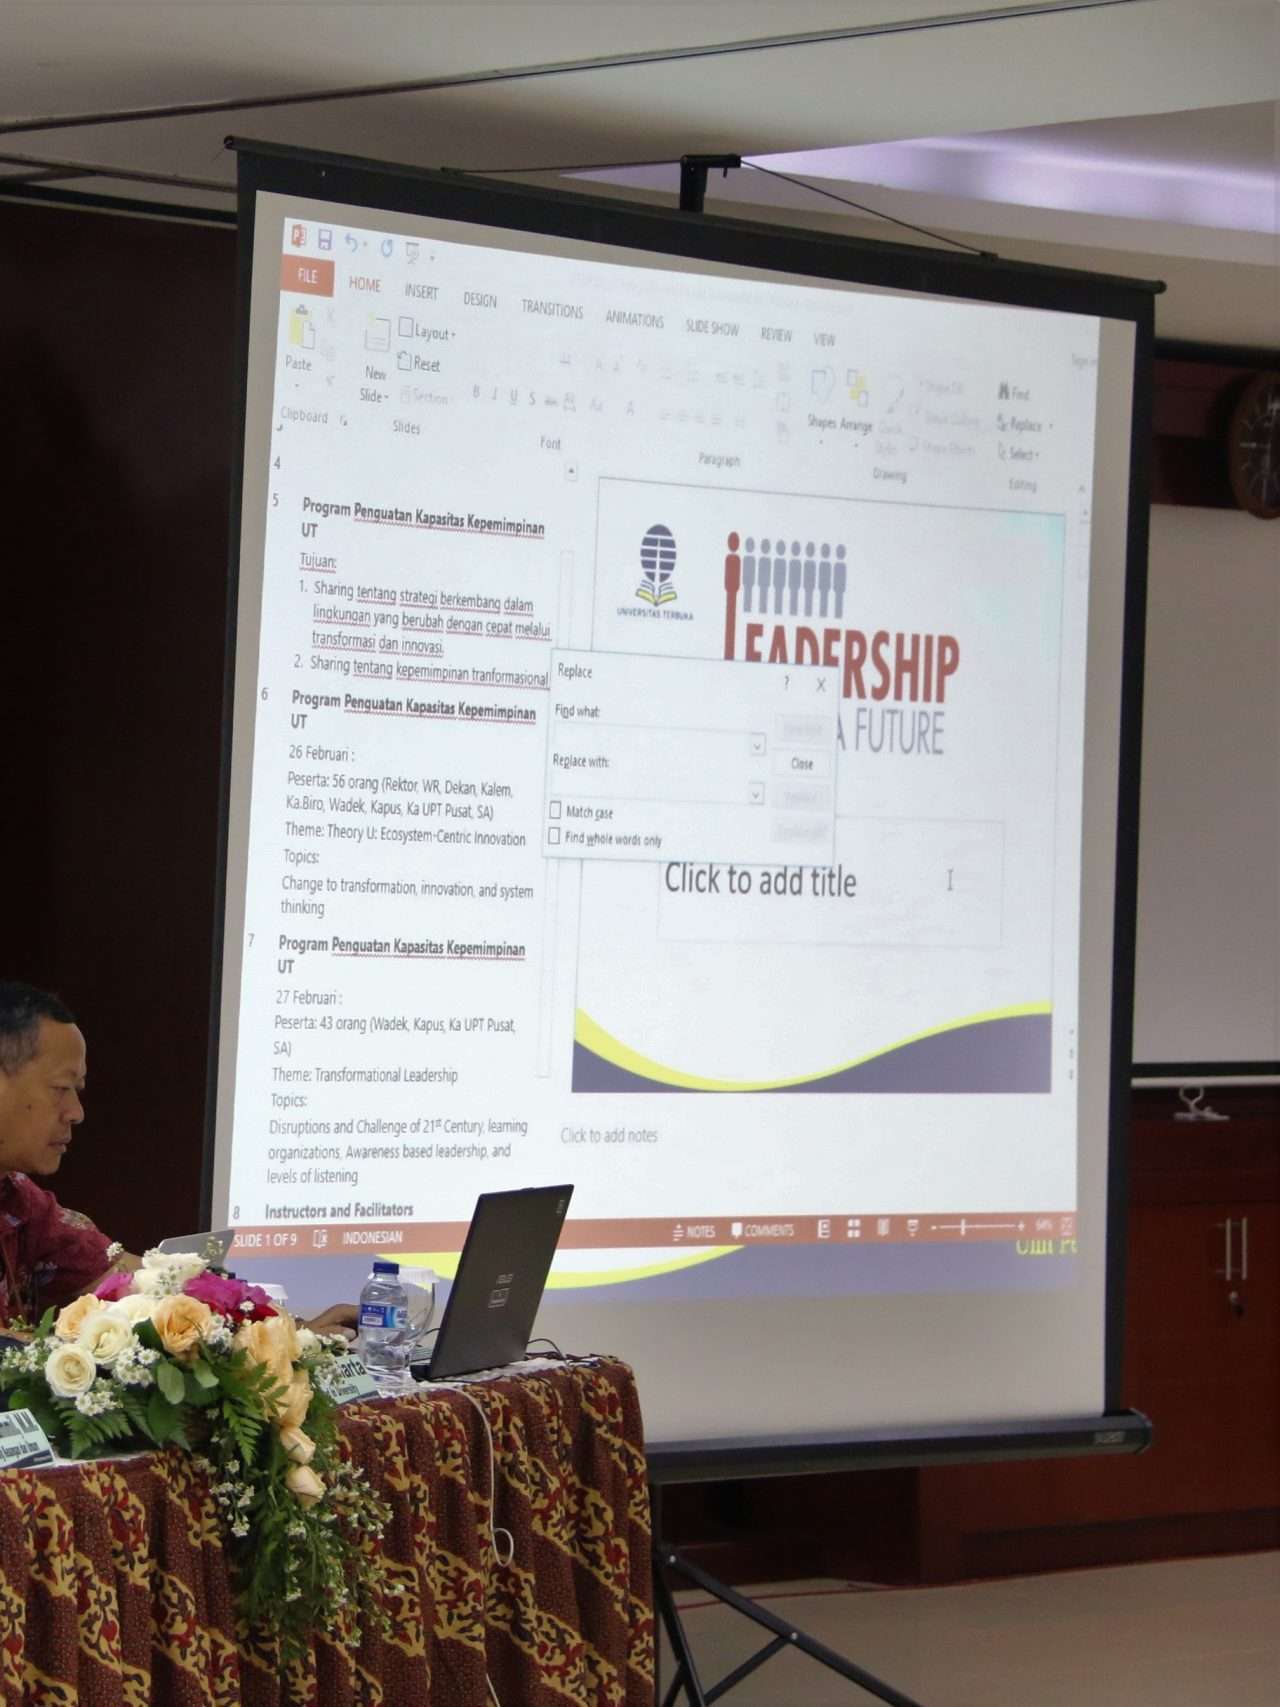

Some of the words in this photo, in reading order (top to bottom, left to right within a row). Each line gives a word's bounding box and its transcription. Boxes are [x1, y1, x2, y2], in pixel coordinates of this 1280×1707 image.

[298, 268, 318, 284] FILE
[349, 276, 381, 292] HOME
[405, 283, 438, 300] INSERT
[463, 292, 497, 308] DESIGN
[522, 300, 584, 319] TRANSITIONS
[606, 310, 665, 329] ANIMATIONS
[686, 319, 710, 335] SLIDE
[712, 321, 739, 337] SHOW
[761, 327, 792, 343] REVIEW
[814, 333, 835, 347] VIEW
[415, 323, 449, 342] Layout
[286, 356, 312, 372] Paste
[414, 358, 440, 373] Reset
[365, 366, 386, 381] New
[360, 388, 382, 403] Slide
[281, 406, 328, 425] Clipboard
[808, 413, 837, 431] Shapes
[840, 417, 873, 435] Arrange
[393, 420, 420, 435] Slides
[540, 436, 561, 451] Font
[699, 452, 741, 468] Paragraph
[873, 467, 907, 484] Drawing
[303, 497, 351, 518] Program
[354, 502, 413, 522] Penguatan
[416, 508, 464, 527] Kapasitas
[467, 514, 545, 535] Kepemimpinan
[301, 522, 318, 538] UT
[300, 552, 337, 570] Tujuan:
[314, 581, 354, 601] Sharing
[357, 585, 396, 601] tentang
[399, 589, 438, 605] strategi
[440, 593, 501, 610] berkembang
[504, 599, 534, 612] dalam
[313, 605, 371, 622] lingkungan
[373, 612, 399, 628] yang
[402, 613, 444, 628] berubah
[446, 618, 483, 632] dengan
[485, 621, 513, 635] cepat
[515, 623, 551, 638] melalui
[617, 607, 660, 619] UNIVERSITAS
[663, 610, 694, 621] TERBUKA
[312, 631, 376, 648] transformasi
[379, 636, 399, 650] dan
[310, 655, 351, 676] Sharing
[353, 659, 393, 676] tentang
[396, 663, 469, 681] kepemimpinan
[558, 662, 593, 681] Replace
[292, 690, 341, 709] Program
[344, 694, 403, 712] Penguatan
[406, 699, 456, 717] Kapasitas
[458, 704, 536, 721] Kepemimpinan
[555, 703, 575, 718] Find
[577, 705, 600, 718] what:
[291, 714, 308, 729] UT
[855, 707, 945, 755] FUTURE
[288, 745, 303, 759] 26
[305, 745, 349, 762] Februari
[553, 753, 587, 770] Replace
[588, 756, 610, 769] with:
[791, 757, 814, 771] Close
[287, 771, 330, 788] Peserta:
[332, 774, 346, 789] 56
[349, 779, 379, 794] orang
[406, 802, 420, 816] Ka
[422, 803, 443, 817] UPT
[476, 805, 494, 822] SA)
[566, 805, 593, 819] Match
[595, 808, 613, 821] case
[285, 822, 325, 838] Theme:
[327, 824, 364, 844] Theory
[380, 829, 472, 846] Ecosystem-Centric
[474, 831, 526, 847] Innovation
[565, 830, 585, 844] Find
[587, 832, 613, 846] whole
[615, 834, 641, 846] words
[643, 835, 662, 848] only
[284, 849, 320, 866] Topics:
[282, 875, 324, 895] Change
[326, 878, 338, 892] to
[478, 883, 497, 898] and
[500, 884, 534, 901] system
[665, 862, 720, 894] Click
[728, 865, 752, 895] to
[759, 865, 803, 896] add
[811, 866, 857, 897] title
[281, 900, 325, 919] thinking
[279, 935, 329, 955] Program
[331, 937, 391, 955] Penguatan
[394, 938, 444, 956] Kapasitas
[446, 940, 526, 958] Kepemimpinan
[277, 960, 295, 974] UT
[276, 990, 290, 1005] 27
[292, 990, 337, 1005] Februari
[274, 1015, 318, 1030] Peserta:
[319, 1016, 333, 1031] 43
[336, 1019, 367, 1035] orang
[449, 1018, 462, 1032] Ka
[464, 1018, 485, 1032] UPT
[273, 1041, 292, 1057] SA)
[272, 1068, 313, 1083] Theme:
[315, 1067, 401, 1083] Transformational
[403, 1068, 458, 1085] Leadership
[271, 1093, 308, 1110] Topics:
[269, 1119, 331, 1137] Disruptions
[333, 1119, 354, 1134] and
[356, 1118, 408, 1138] Challenge
[410, 1118, 421, 1133] of
[487, 1118, 528, 1137] learning
[561, 1126, 587, 1143] Click
[589, 1128, 601, 1143] to
[604, 1126, 626, 1143] add
[628, 1128, 659, 1144] notes
[345, 1145, 400, 1160] Awareness
[402, 1144, 433, 1159] based
[491, 1143, 512, 1157] and
[267, 1168, 297, 1184] levels
[299, 1167, 313, 1184] of
[314, 1167, 359, 1187] listening
[265, 1203, 328, 1219] Instructors
[330, 1203, 351, 1218] and
[354, 1202, 414, 1218] Facilitators
[233, 1233, 262, 1247] SLIDE
[273, 1233, 287, 1246] OF
[289, 1232, 297, 1246] 9
[342, 1230, 403, 1244] INDONESIAN
[687, 1225, 715, 1239] NOTES
[745, 1222, 795, 1238] COMMENTS
